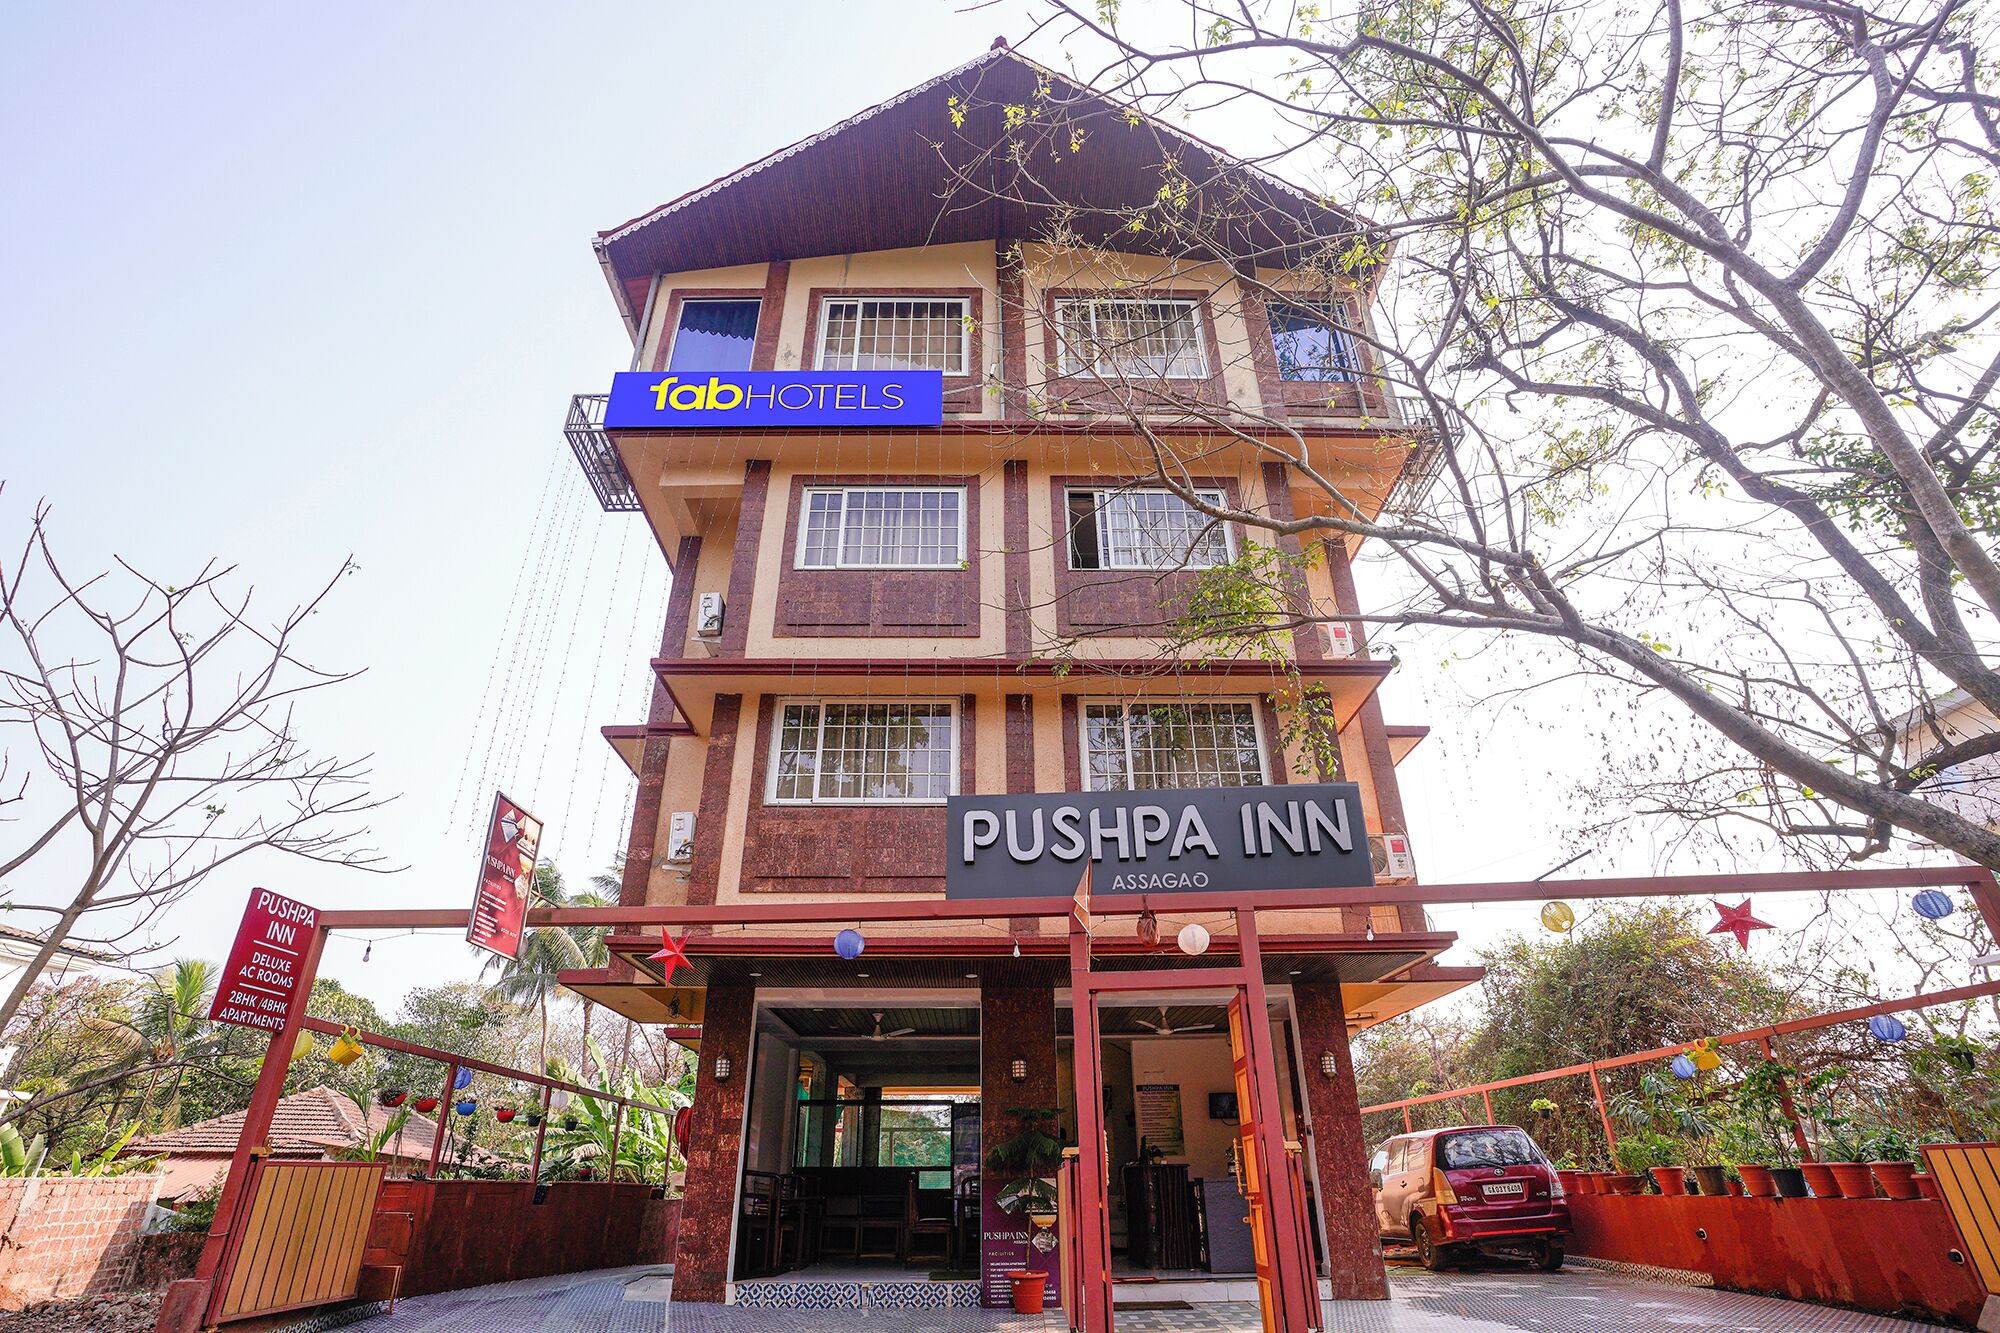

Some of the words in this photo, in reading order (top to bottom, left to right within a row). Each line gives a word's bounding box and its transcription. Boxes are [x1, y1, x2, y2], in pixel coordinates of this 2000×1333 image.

[963, 803, 1220, 864] PUSHPA
[1240, 797, 1354, 857] INN
[1112, 872, 1209, 890] ASSAGAO
[257, 891, 316, 929] PUSHPA
[266, 920, 296, 946] INN
[252, 951, 292, 973] DELUXE
[239, 965, 256, 979] AC
[257, 969, 294, 988] ROOMS
[228, 990, 258, 1008] 2BHK
[219, 1007, 286, 1031] APARTMENTS
[983, 1231, 1015, 1240] PUSHPA
